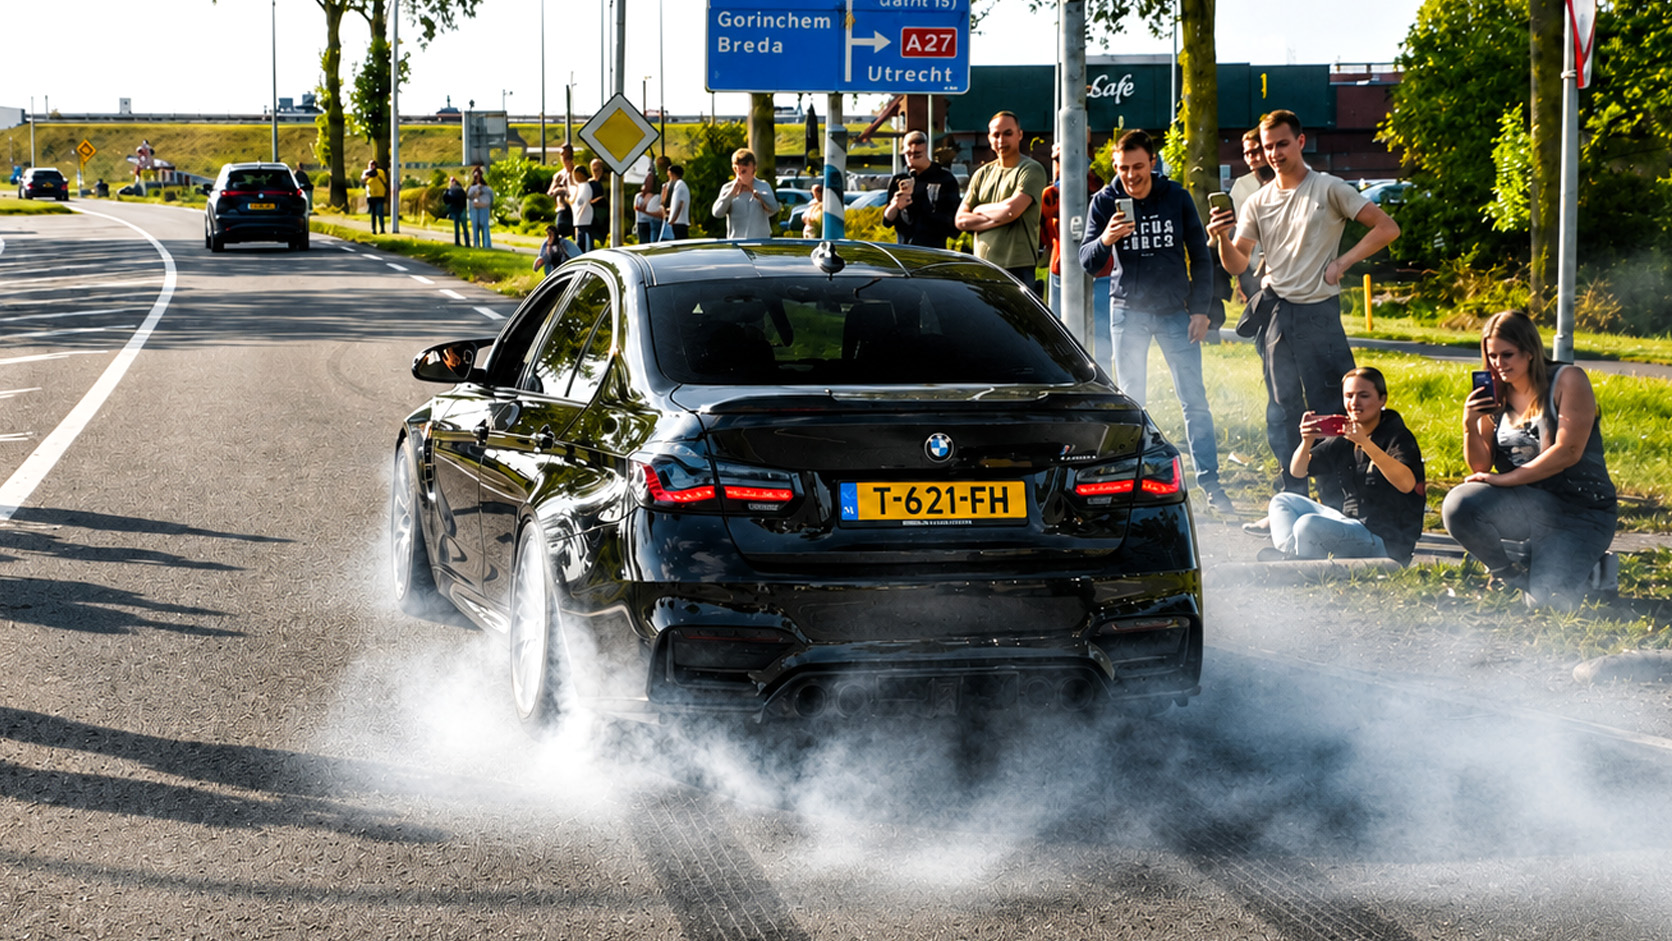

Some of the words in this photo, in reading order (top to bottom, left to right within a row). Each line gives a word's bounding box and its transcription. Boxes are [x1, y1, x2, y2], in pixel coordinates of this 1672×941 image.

[717, 11, 831, 29] Gorinchem
[718, 37, 783, 53] Breda
[905, 34, 953, 52] A27
[868, 66, 953, 82] Utrecht
[873, 485, 1009, 515] T-621-FH
